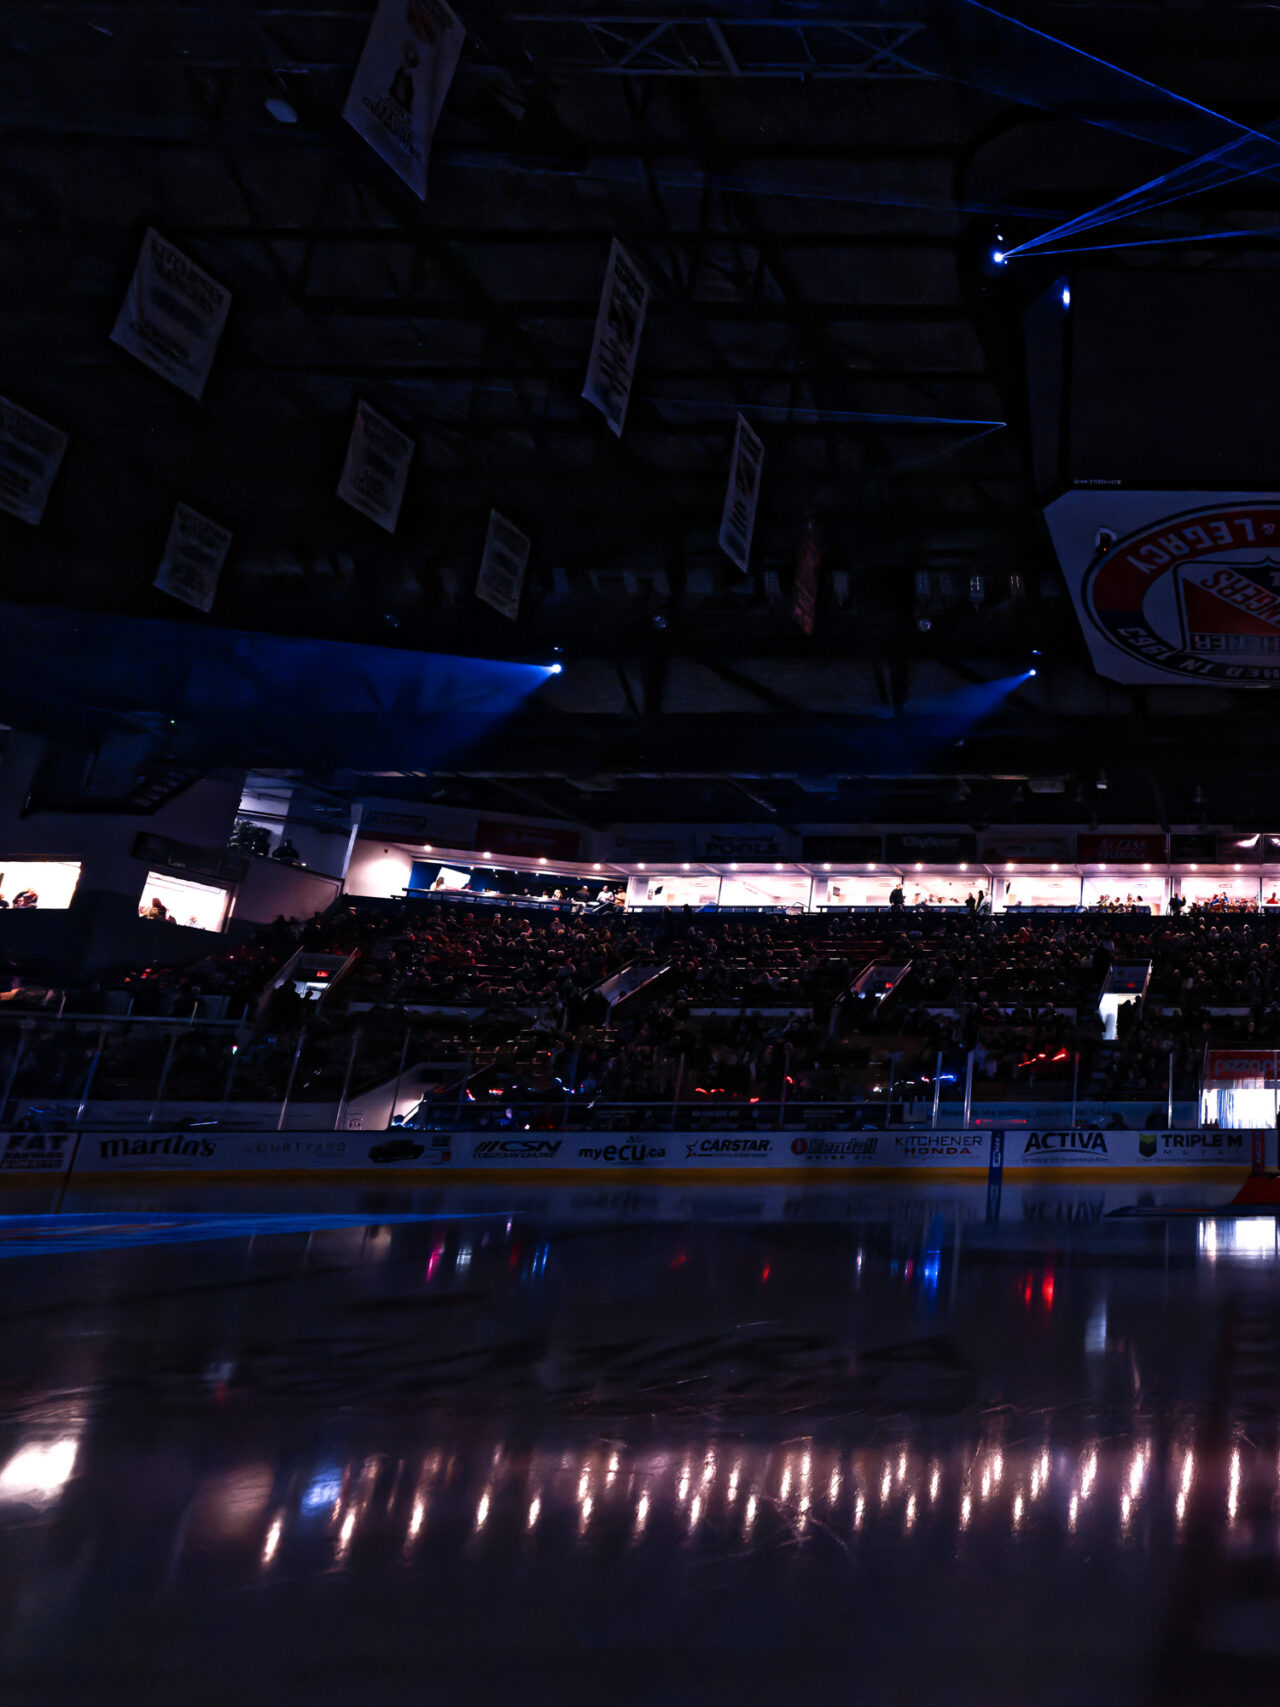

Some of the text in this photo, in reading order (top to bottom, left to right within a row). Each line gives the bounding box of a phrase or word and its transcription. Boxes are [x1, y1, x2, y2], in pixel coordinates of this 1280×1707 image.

[1124, 517, 1258, 577] LEGACY
[1115, 624, 1177, 663] 1963
[1178, 655, 1216, 677] IN
[706, 843, 780, 855] POOLS
[8, 1136, 69, 1150] FAT
[101, 1136, 215, 1158] martin's
[501, 1141, 562, 1152] CSN
[808, 1138, 878, 1154] Kendall
[895, 1136, 983, 1147] KITCHENER
[1023, 1132, 1108, 1153] ACTIVA
[1161, 1134, 1242, 1147] TRIPLE M
